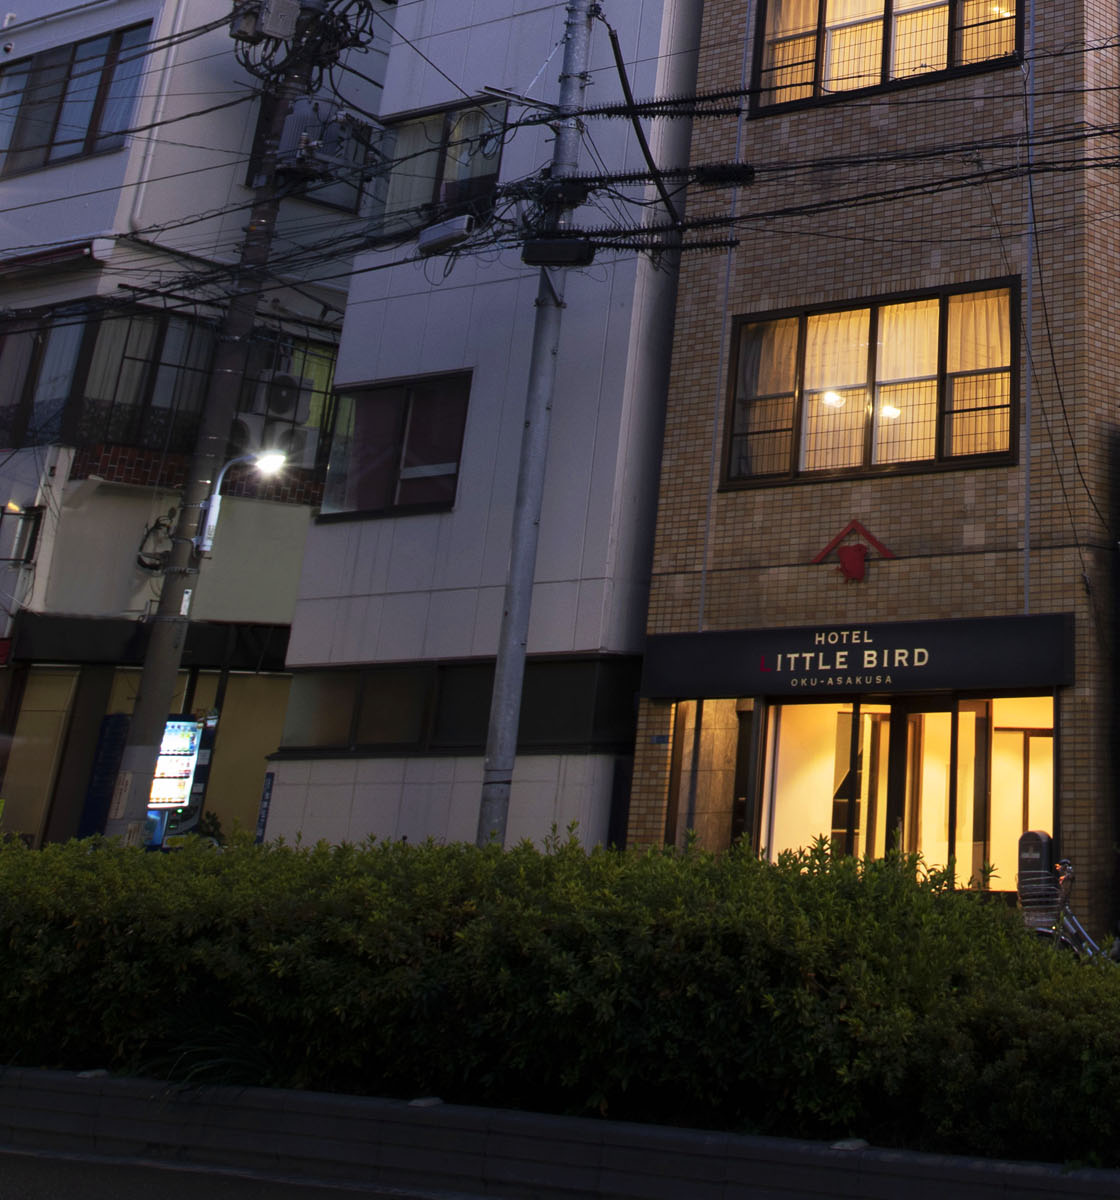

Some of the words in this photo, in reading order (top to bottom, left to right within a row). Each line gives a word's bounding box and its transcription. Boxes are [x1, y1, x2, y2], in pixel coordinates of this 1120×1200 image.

[815, 630, 873, 645] HOTEL
[760, 650, 848, 672] LITTLE
[863, 648, 929, 669] BIRD
[790, 675, 893, 687] OKU-ASAKUSA
